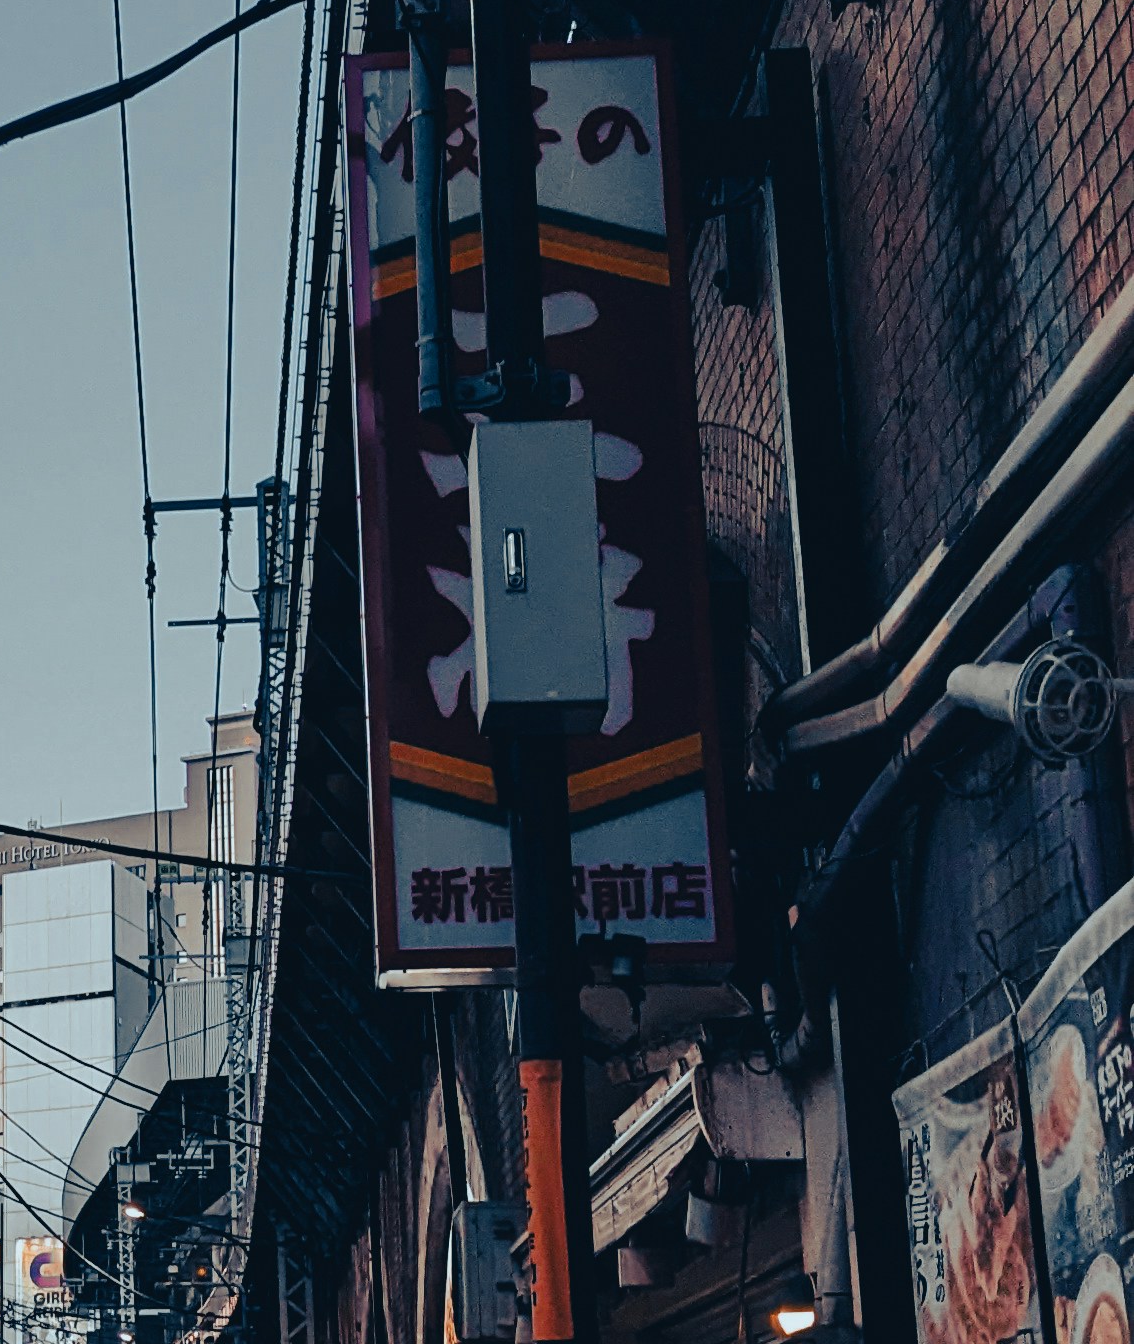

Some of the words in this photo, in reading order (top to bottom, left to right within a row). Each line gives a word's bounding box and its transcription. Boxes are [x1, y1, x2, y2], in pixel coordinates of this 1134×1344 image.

[10, 843, 59, 863] HOTEL
[411, 863, 707, 925] 新橋前店
